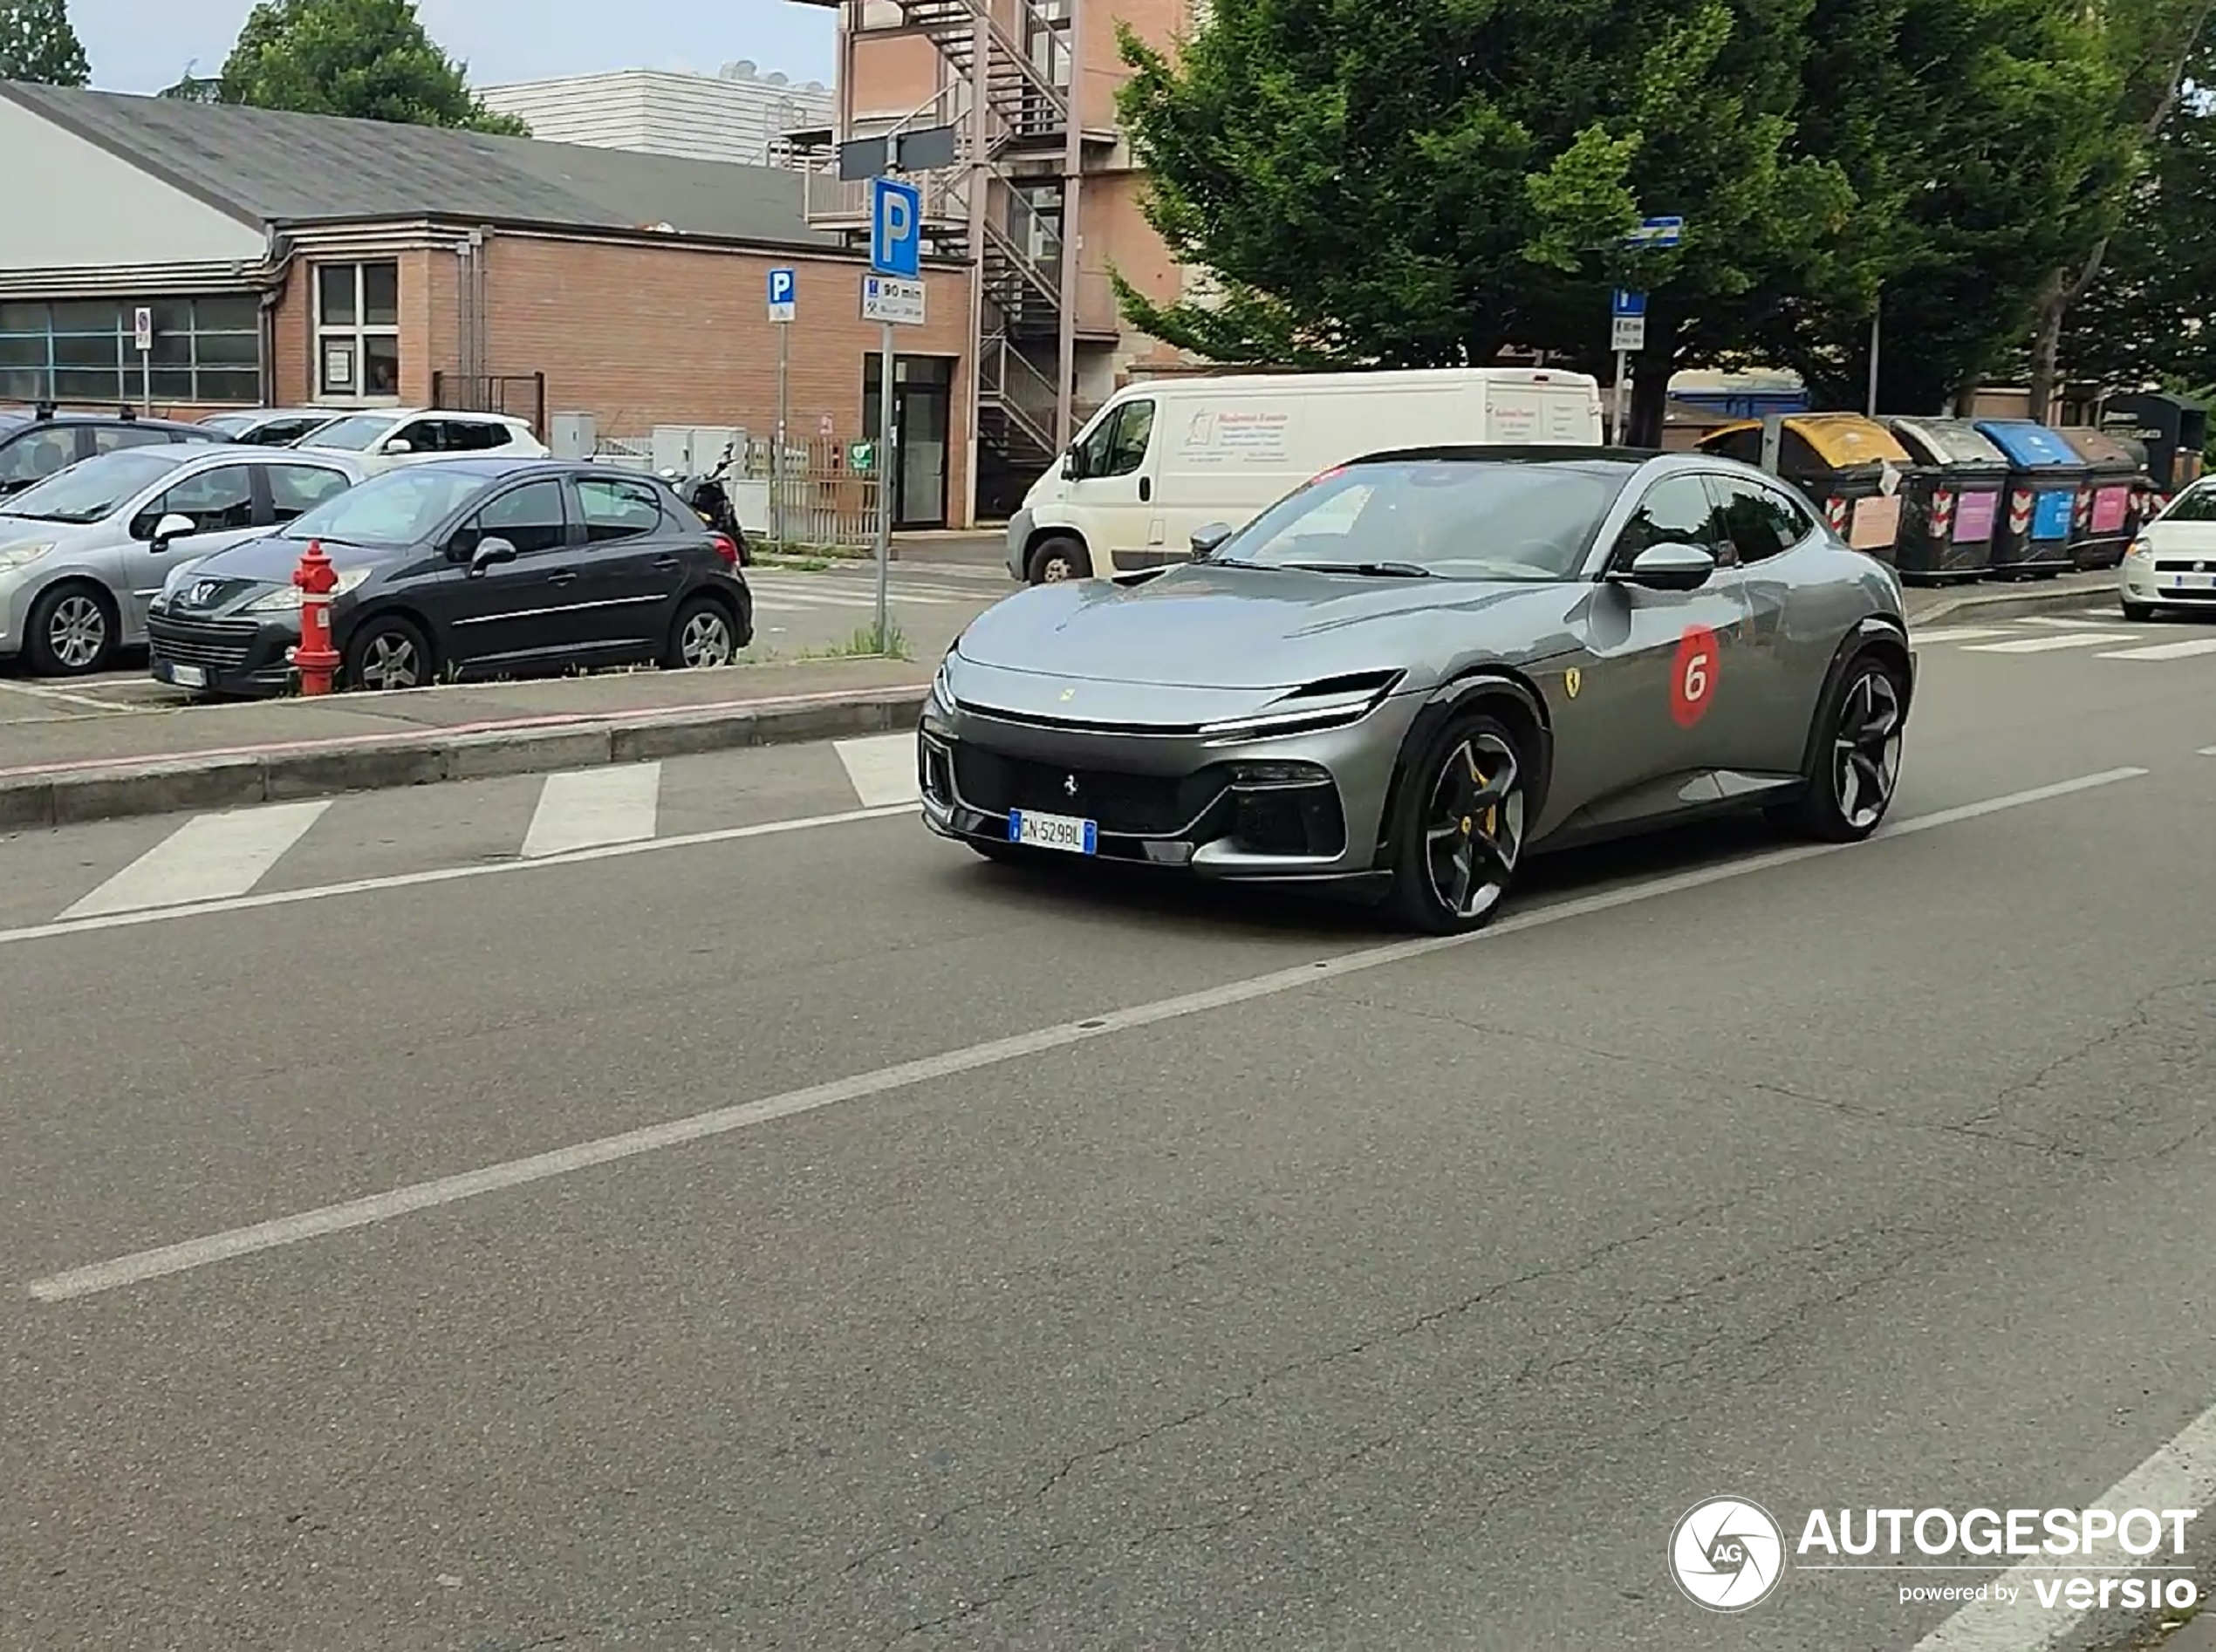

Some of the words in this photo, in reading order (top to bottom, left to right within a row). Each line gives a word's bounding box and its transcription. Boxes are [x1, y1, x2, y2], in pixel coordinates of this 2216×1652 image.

[882, 190, 912, 263] P
[773, 272, 790, 301] P
[1685, 654, 1707, 701] 6
